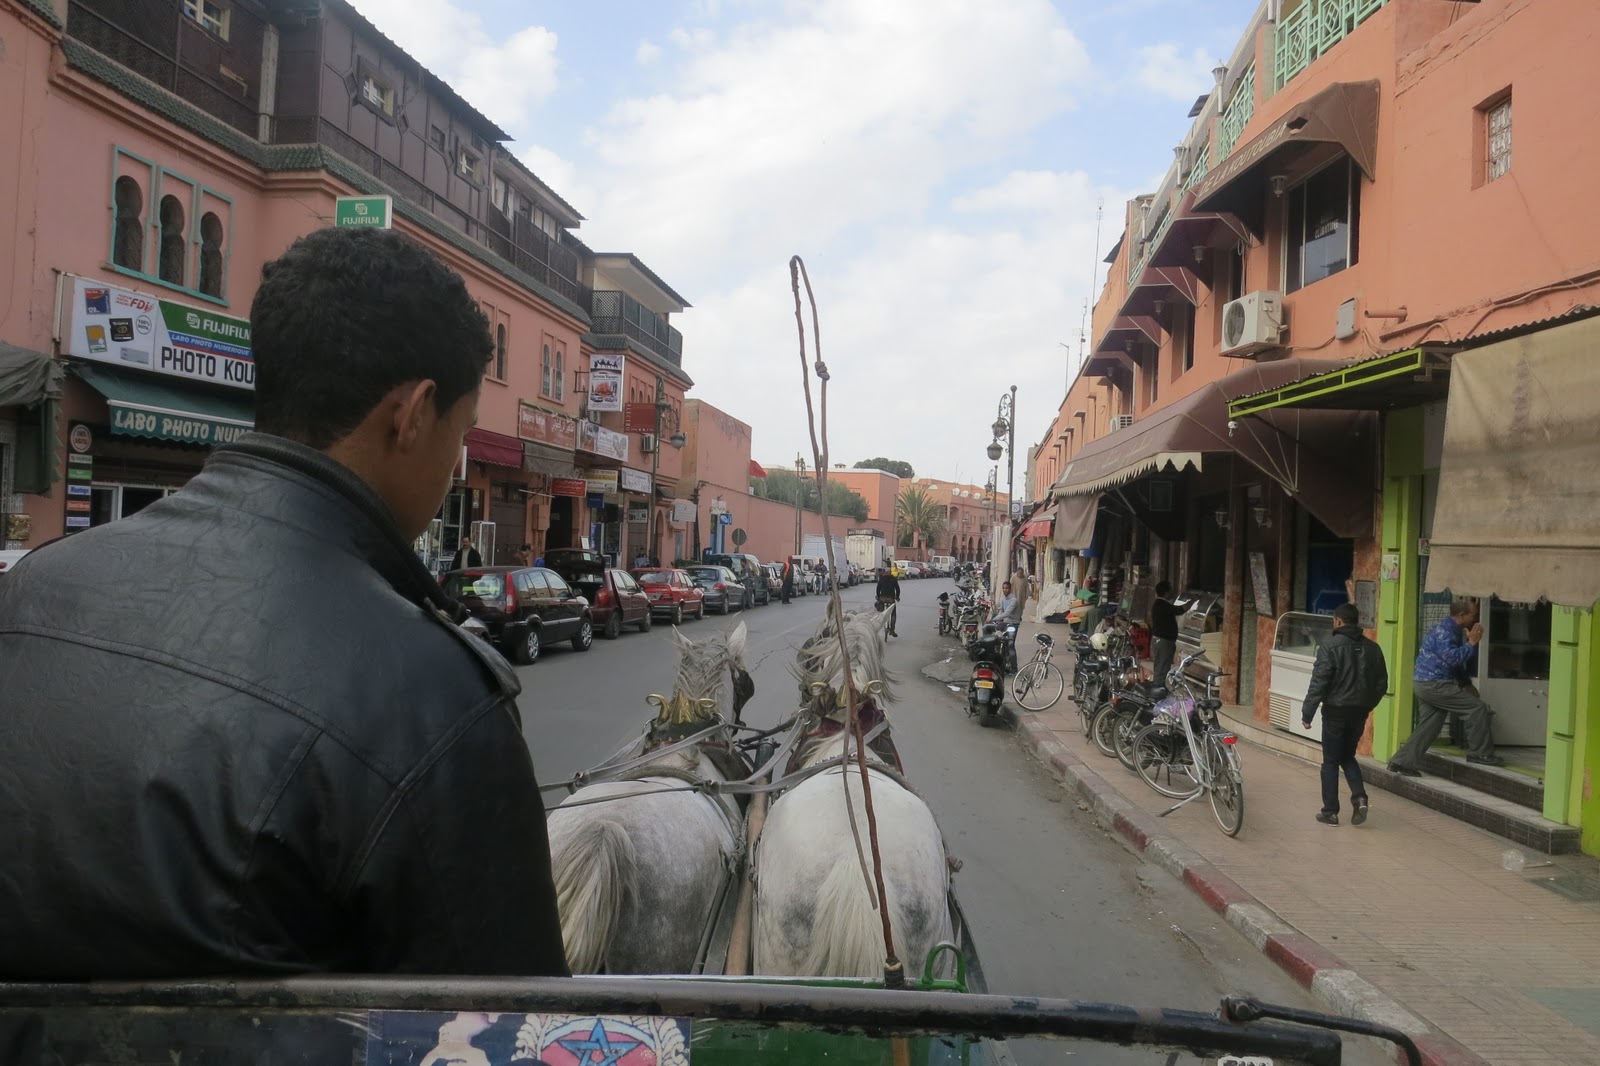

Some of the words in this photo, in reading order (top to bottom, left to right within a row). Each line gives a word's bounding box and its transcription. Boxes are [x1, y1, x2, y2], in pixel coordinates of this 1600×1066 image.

[1199, 176, 1215, 197] DE
[1213, 165, 1229, 187] LA
[1227, 121, 1288, 176] KOUTOUBIA
[342, 216, 380, 225] FUJIFILM
[171, 333, 189, 344] LABO
[191, 338, 213, 348] PHOTO
[213, 343, 250, 356] NUMERIQUE
[161, 346, 216, 377] PHOTO
[115, 410, 157, 432] LABO
[162, 418, 210, 440] PHOTO
[214, 425, 253, 443] NUM
